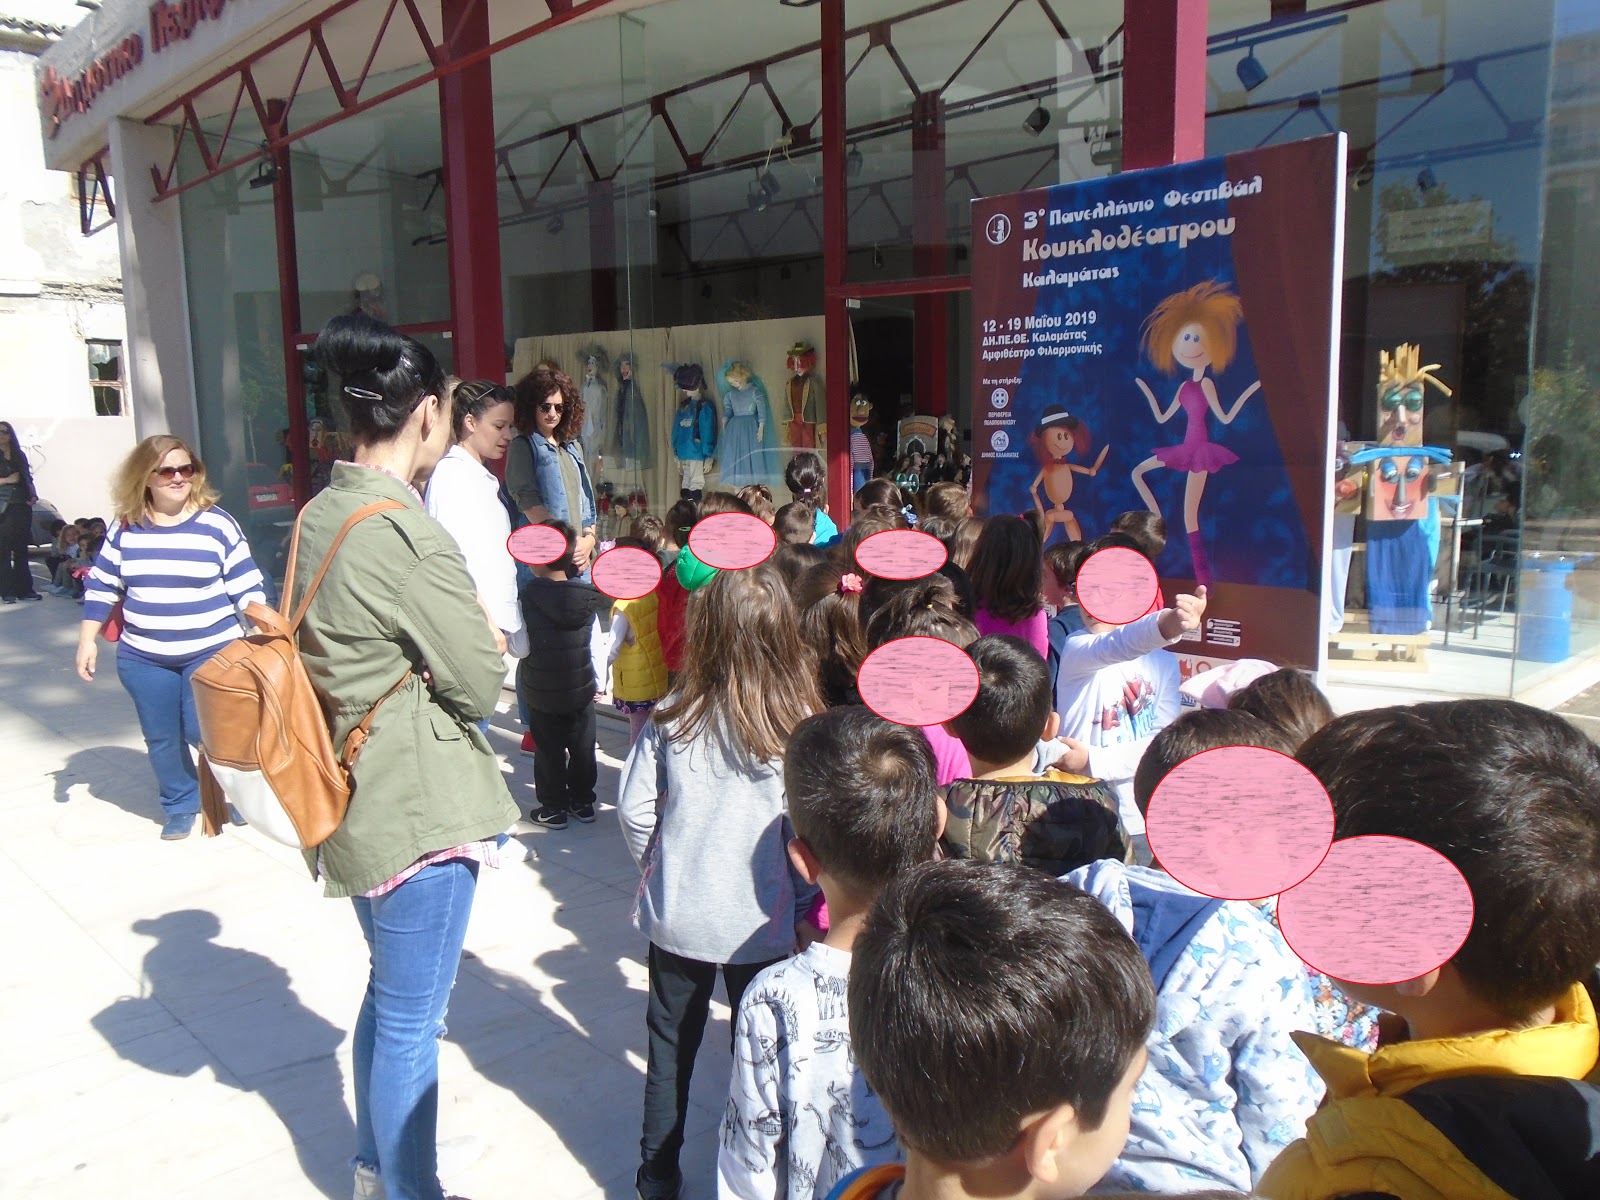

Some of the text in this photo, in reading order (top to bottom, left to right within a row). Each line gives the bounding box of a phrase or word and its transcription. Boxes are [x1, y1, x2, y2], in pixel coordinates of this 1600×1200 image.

[1049, 199, 1155, 226] Πανελλήνιο
[1163, 175, 1263, 208] Φεστιβάλ
[1022, 217, 1237, 261] Κουκλοθέατρου
[1022, 266, 1120, 289] Καλαμάτας
[982, 320, 997, 333] 12
[1007, 317, 1022, 331] 19
[1065, 310, 1097, 326] 2019
[982, 330, 1087, 346] ΔΗ.ΠΕ.ΘΕ. Καλαμάτας
[982, 342, 1103, 362] Αμφιθέατρο Φιλαρμονικής
[991, 378, 998, 386] τη
